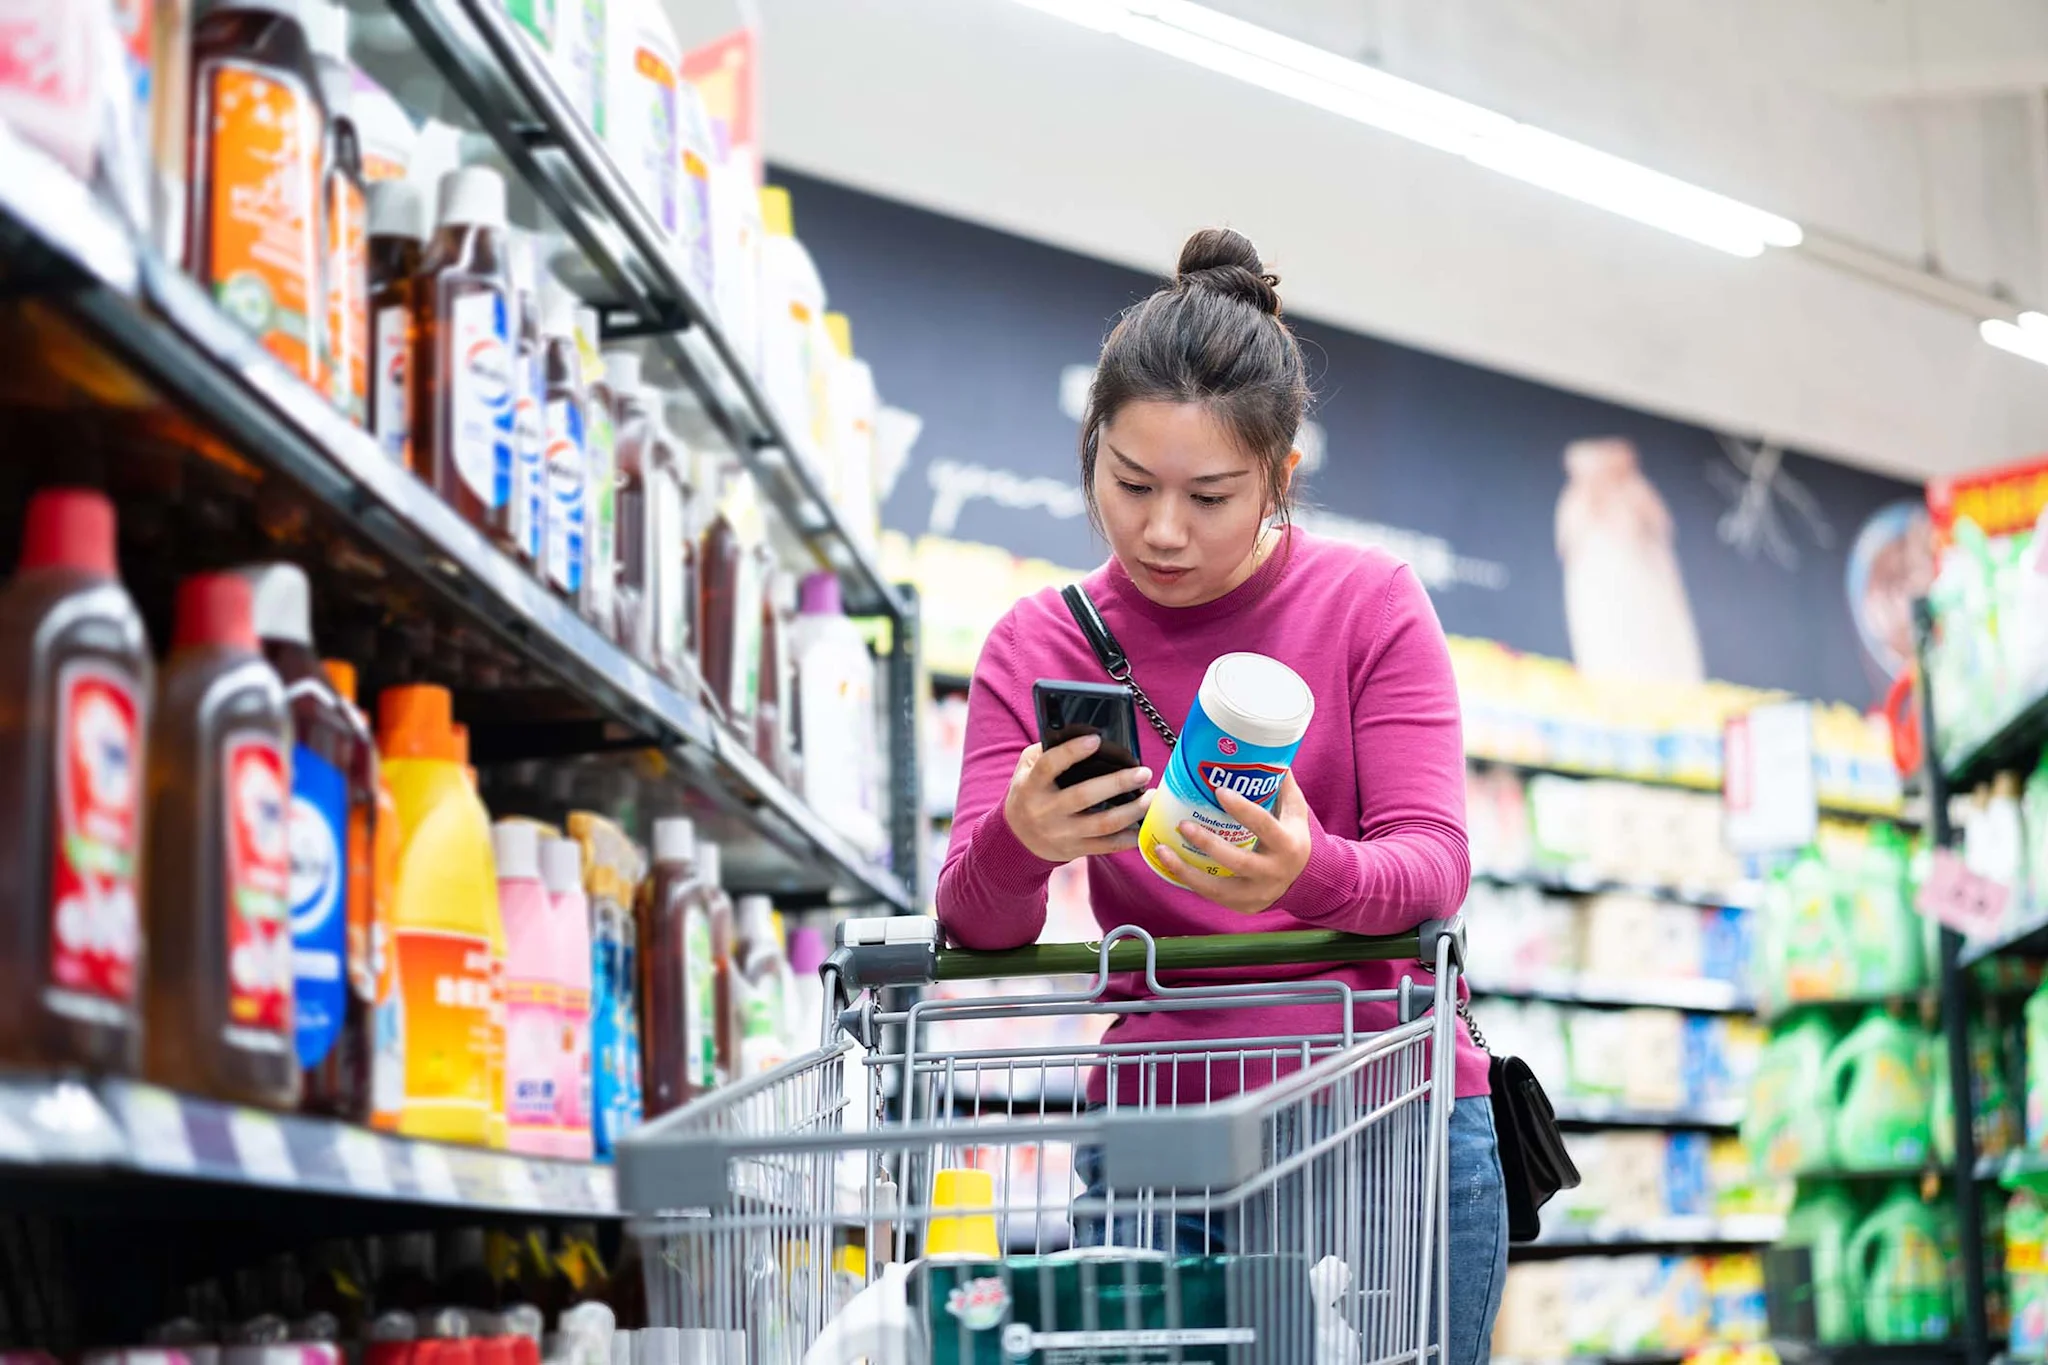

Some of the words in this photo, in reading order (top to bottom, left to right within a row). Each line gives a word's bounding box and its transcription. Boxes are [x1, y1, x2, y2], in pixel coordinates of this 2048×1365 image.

[1208, 766, 1285, 796] CLOROX
[1192, 811, 1242, 830] Disinfecting
[1218, 829, 1244, 838] 99.9%
